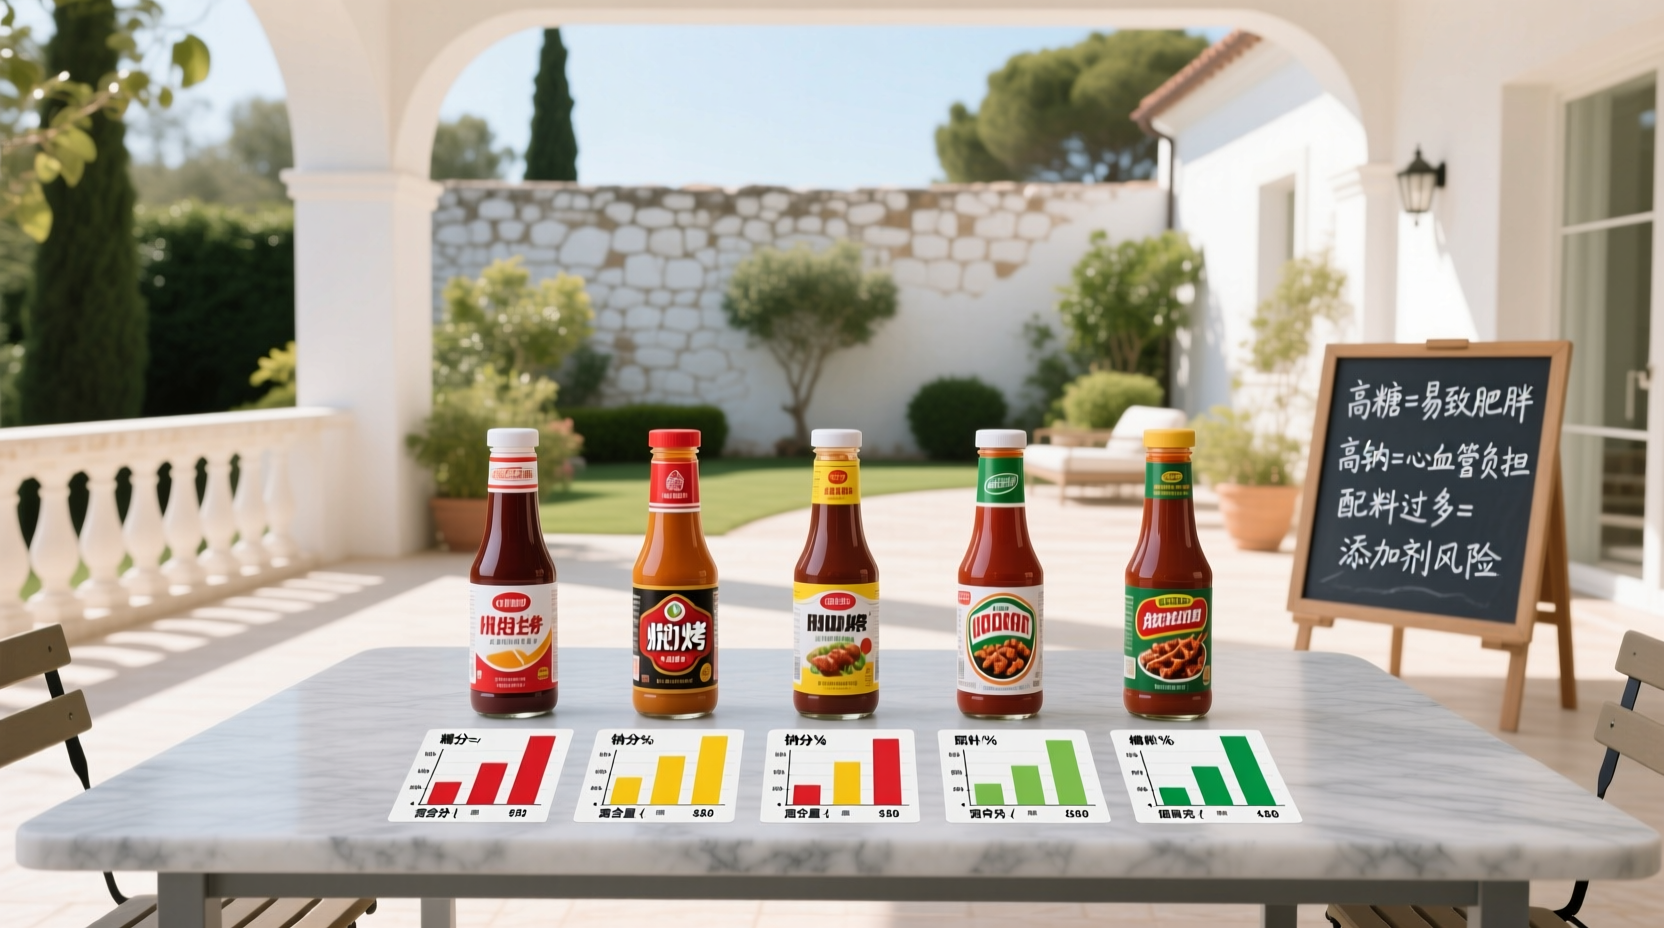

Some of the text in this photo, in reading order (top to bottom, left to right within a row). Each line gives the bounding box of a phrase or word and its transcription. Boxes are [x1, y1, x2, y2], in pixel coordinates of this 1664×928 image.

[1348, 379, 1534, 424] 高糖=易致肥胖
[1338, 437, 1530, 480] 高钠=心血管负担
[1337, 487, 1474, 528] 配料过多=
[1338, 534, 1502, 580] 添加剂风险
